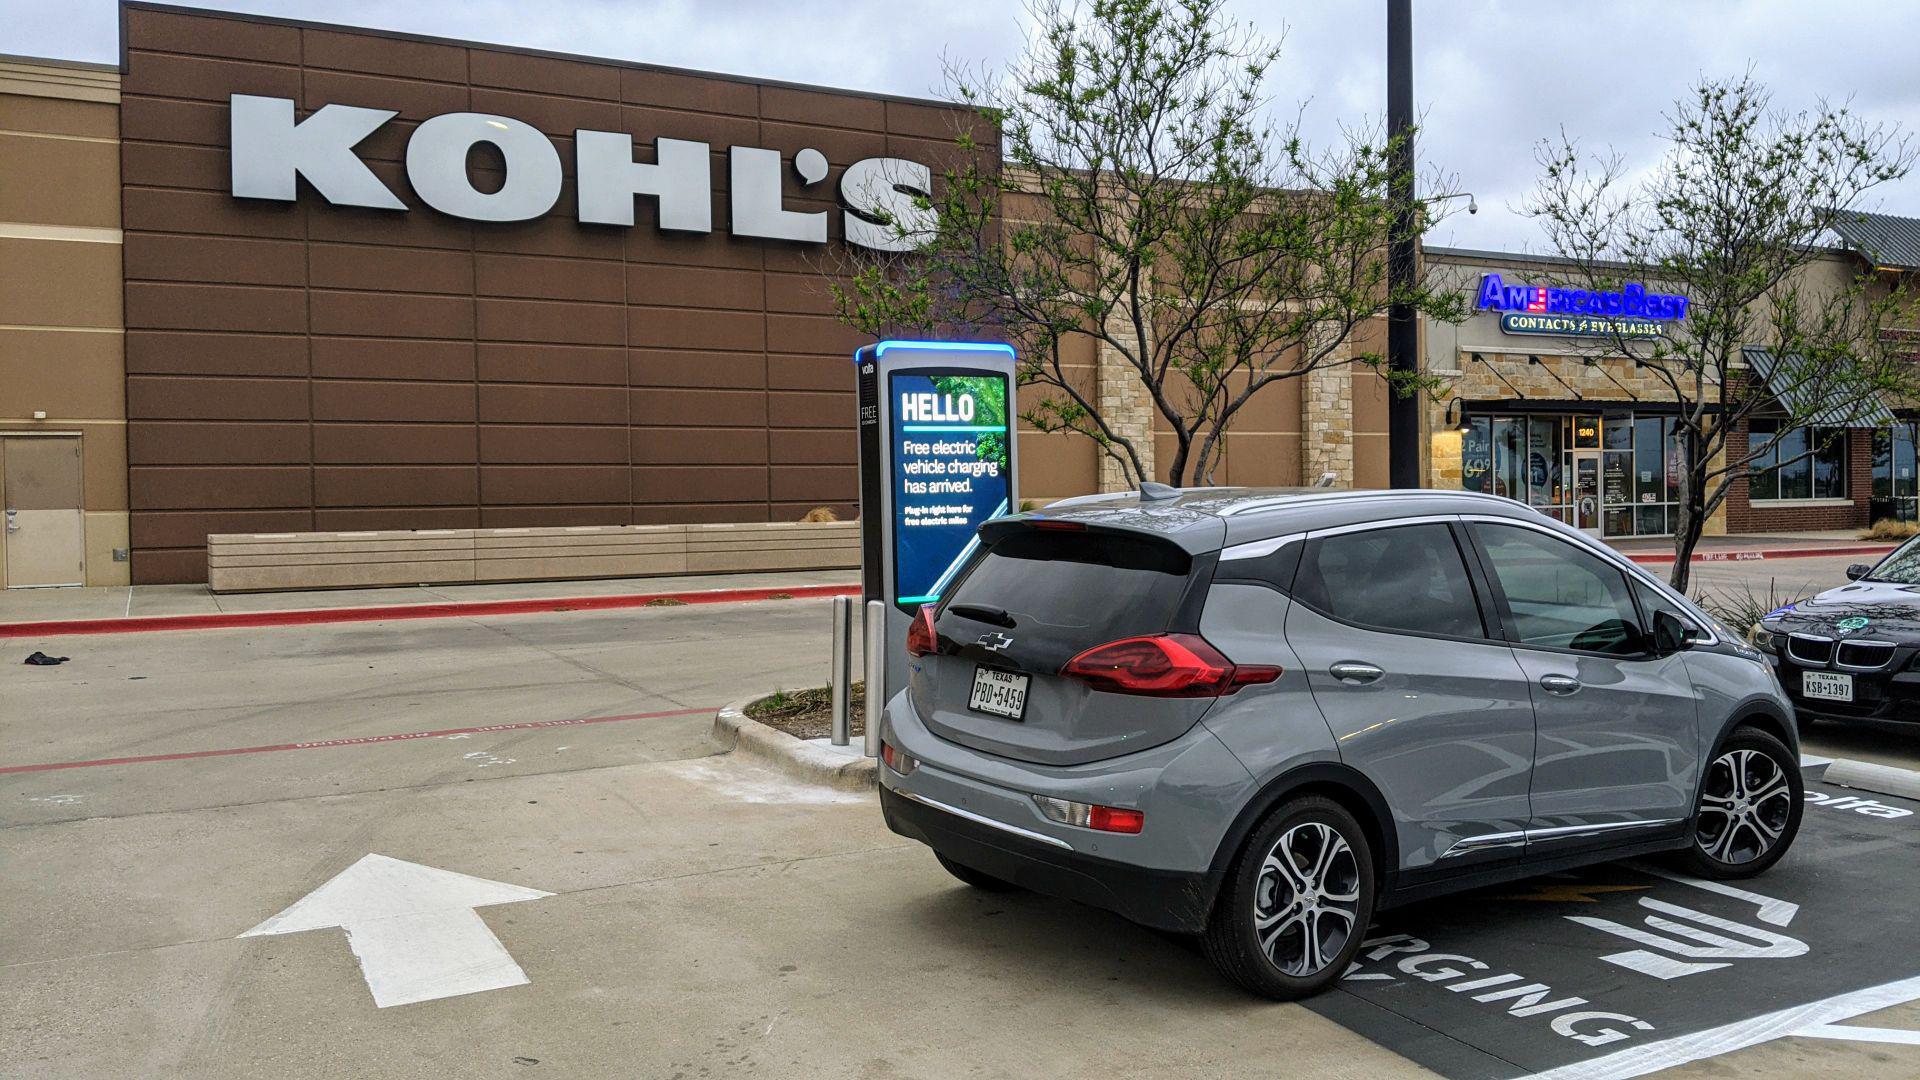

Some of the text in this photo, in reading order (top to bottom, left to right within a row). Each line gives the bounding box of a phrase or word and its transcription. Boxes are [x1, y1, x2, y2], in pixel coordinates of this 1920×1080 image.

[230, 93, 939, 252] KOHL'S
[1510, 316, 1576, 331] CONTACTS
[861, 405, 877, 420] FREE
[902, 393, 974, 422] HELLO
[1579, 428, 1595, 437] 1240
[903, 439, 976, 455] Free electric
[1468, 440, 1490, 453] Pair
[903, 458, 999, 478] vehicle charging
[904, 477, 973, 494] has arrived.
[904, 504, 974, 517] Plug-in right here for
[904, 515, 968, 526] free electric miles
[992, 671, 1013, 683] TEXAS
[1817, 673, 1838, 681] TEXAS
